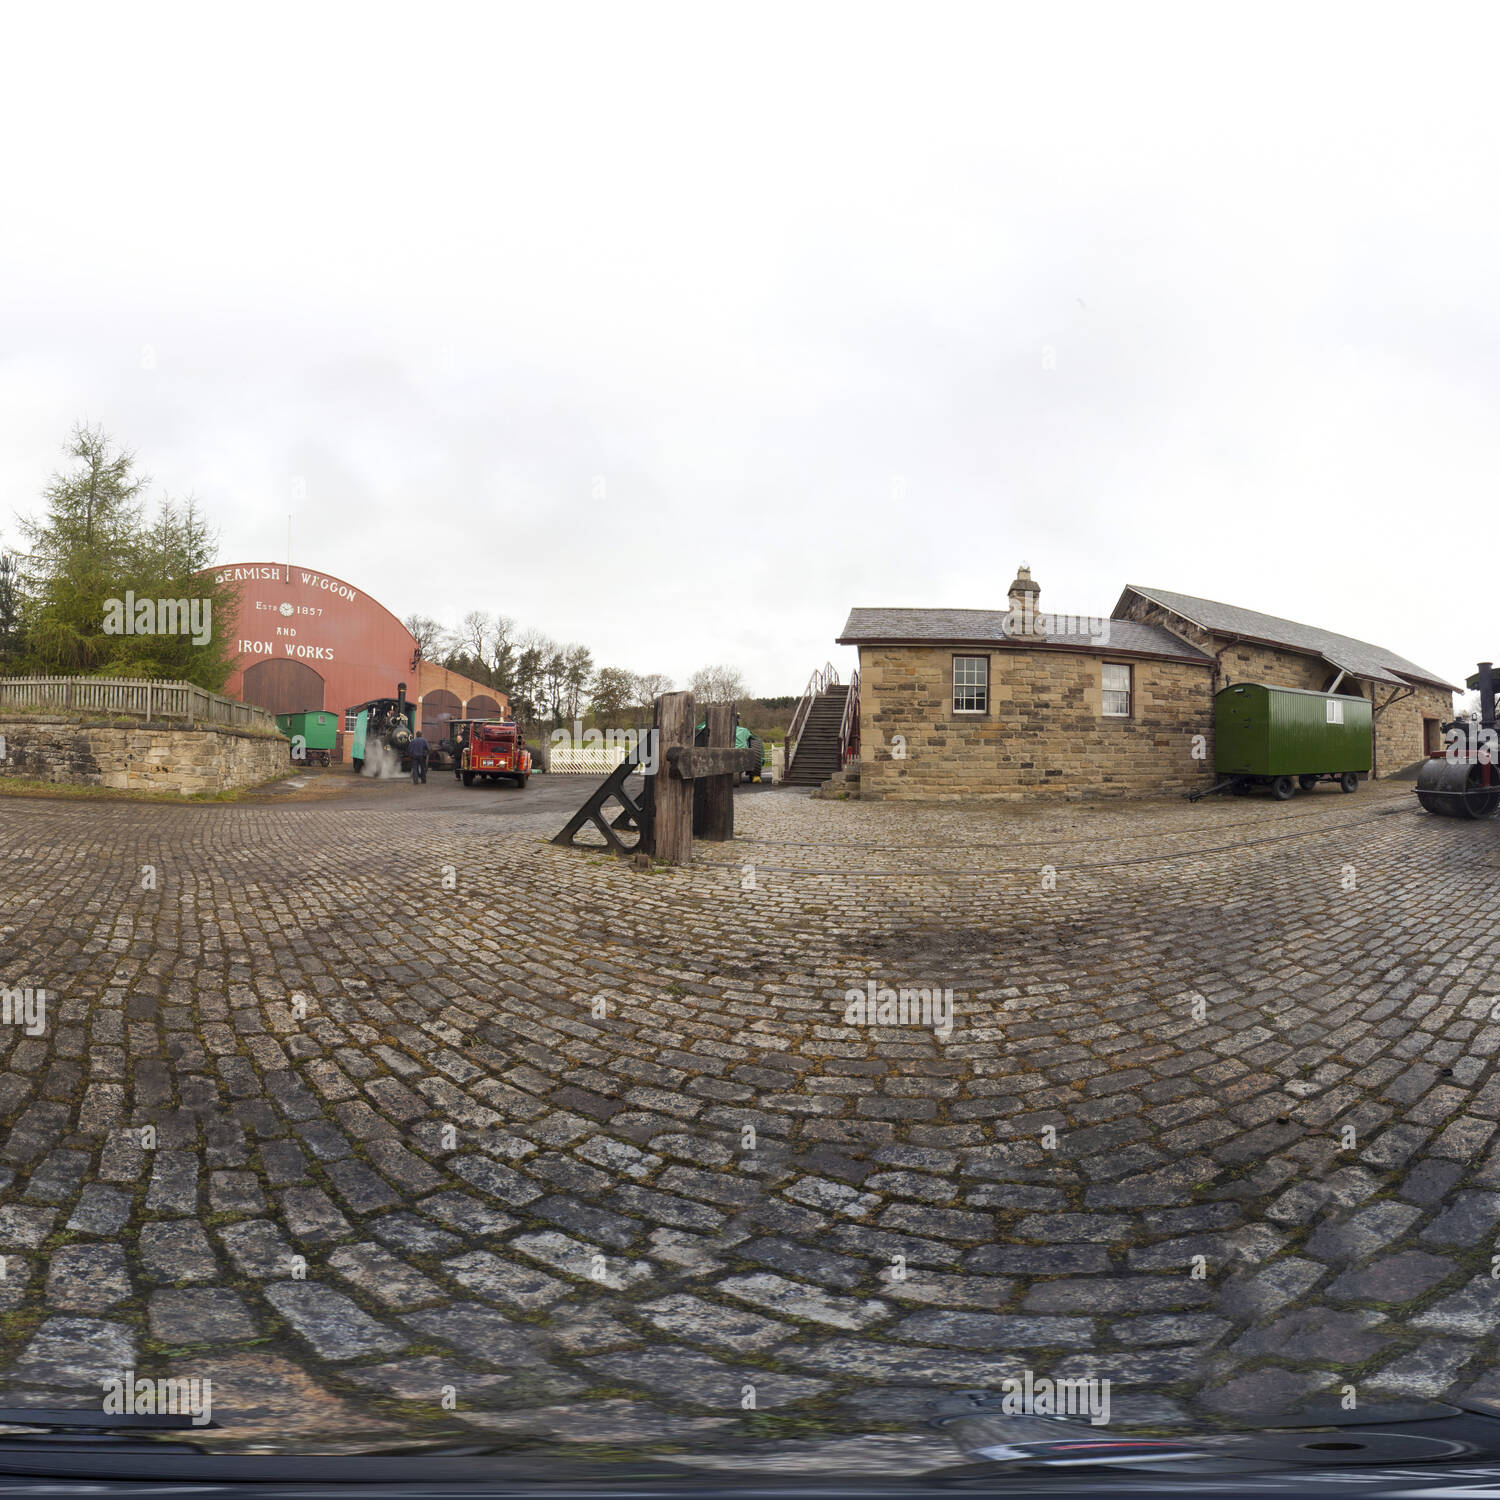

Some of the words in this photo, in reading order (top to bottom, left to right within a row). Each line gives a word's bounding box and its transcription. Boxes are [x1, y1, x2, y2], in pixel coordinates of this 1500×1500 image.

[296, 606, 323, 616] 1857
[276, 627, 296, 636] AND
[238, 640, 273, 654] IRON
[285, 643, 334, 660] WORKS
